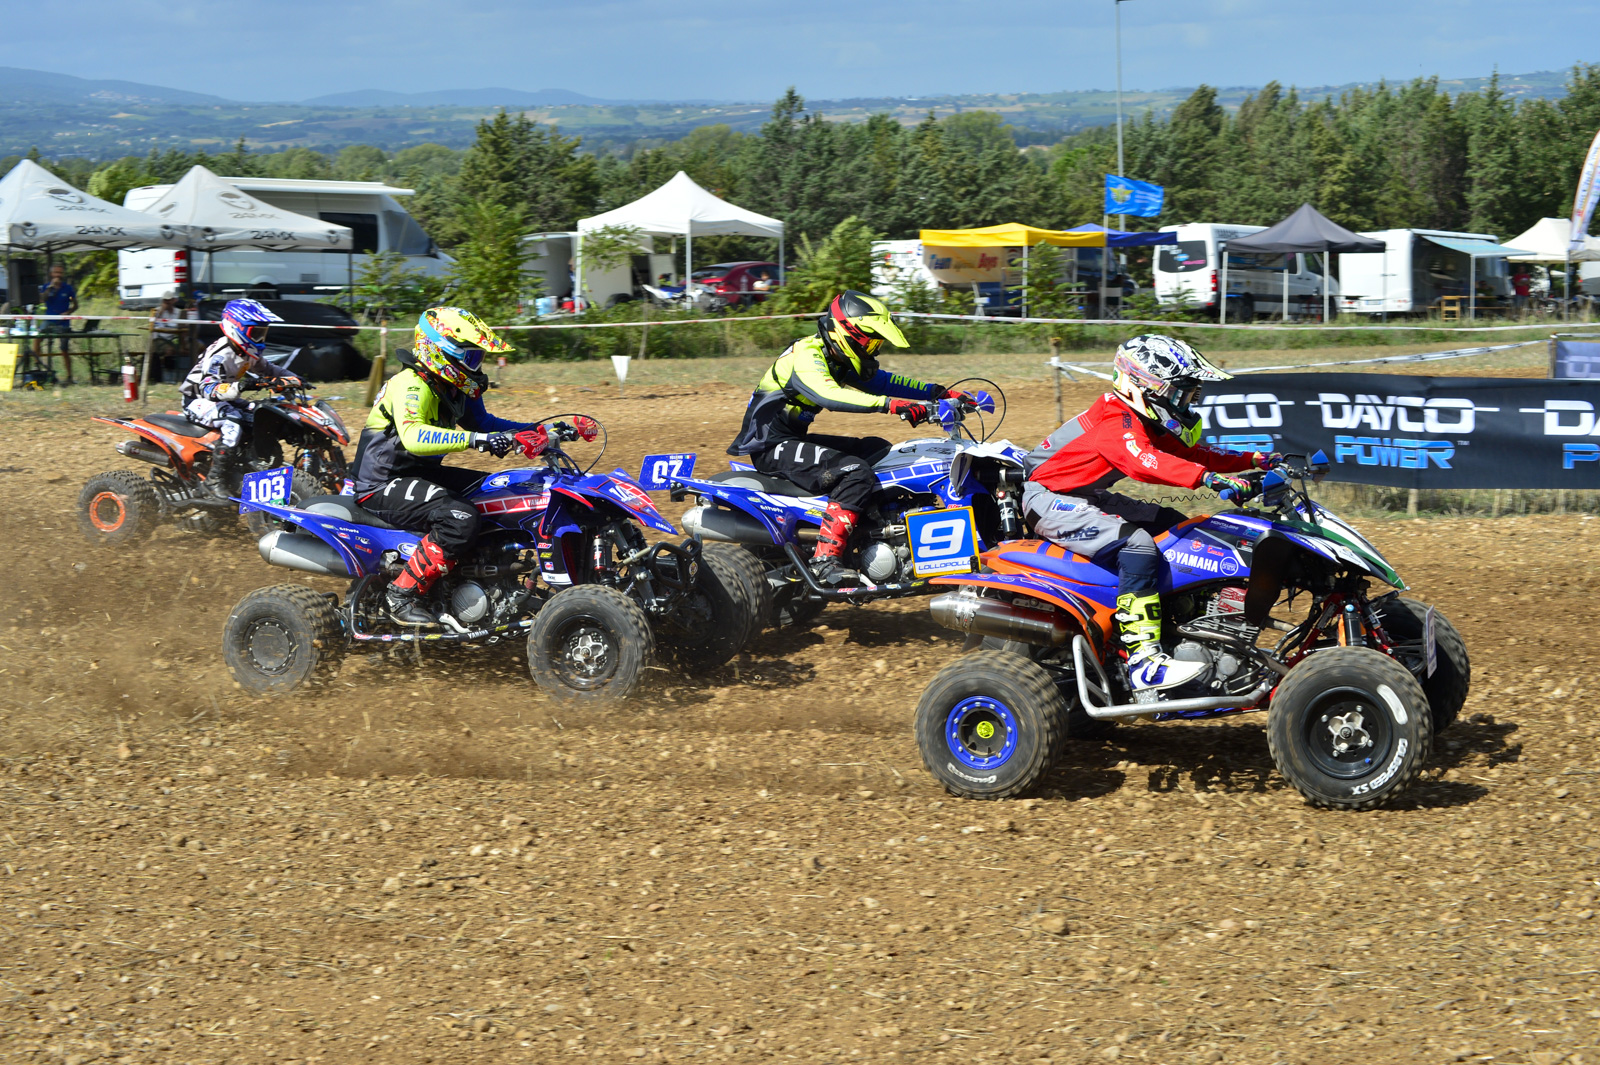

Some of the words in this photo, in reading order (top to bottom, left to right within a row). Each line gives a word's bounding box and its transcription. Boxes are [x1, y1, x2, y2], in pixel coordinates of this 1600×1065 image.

[75, 225, 127, 236] 24MX
[251, 230, 297, 241] 24MX
[1318, 393, 1475, 433] DAYCO
[417, 428, 466, 444] YAMAHA
[774, 440, 829, 464] FLY
[1335, 435, 1455, 469] POWER
[652, 460, 683, 484] 07
[248, 475, 285, 503] 103
[383, 477, 444, 502] FLY
[655, 522, 672, 532] YAMAHA
[917, 518, 966, 559] 9
[1175, 551, 1218, 573] YAMAHA
[468, 630, 489, 639] YAMAHA
